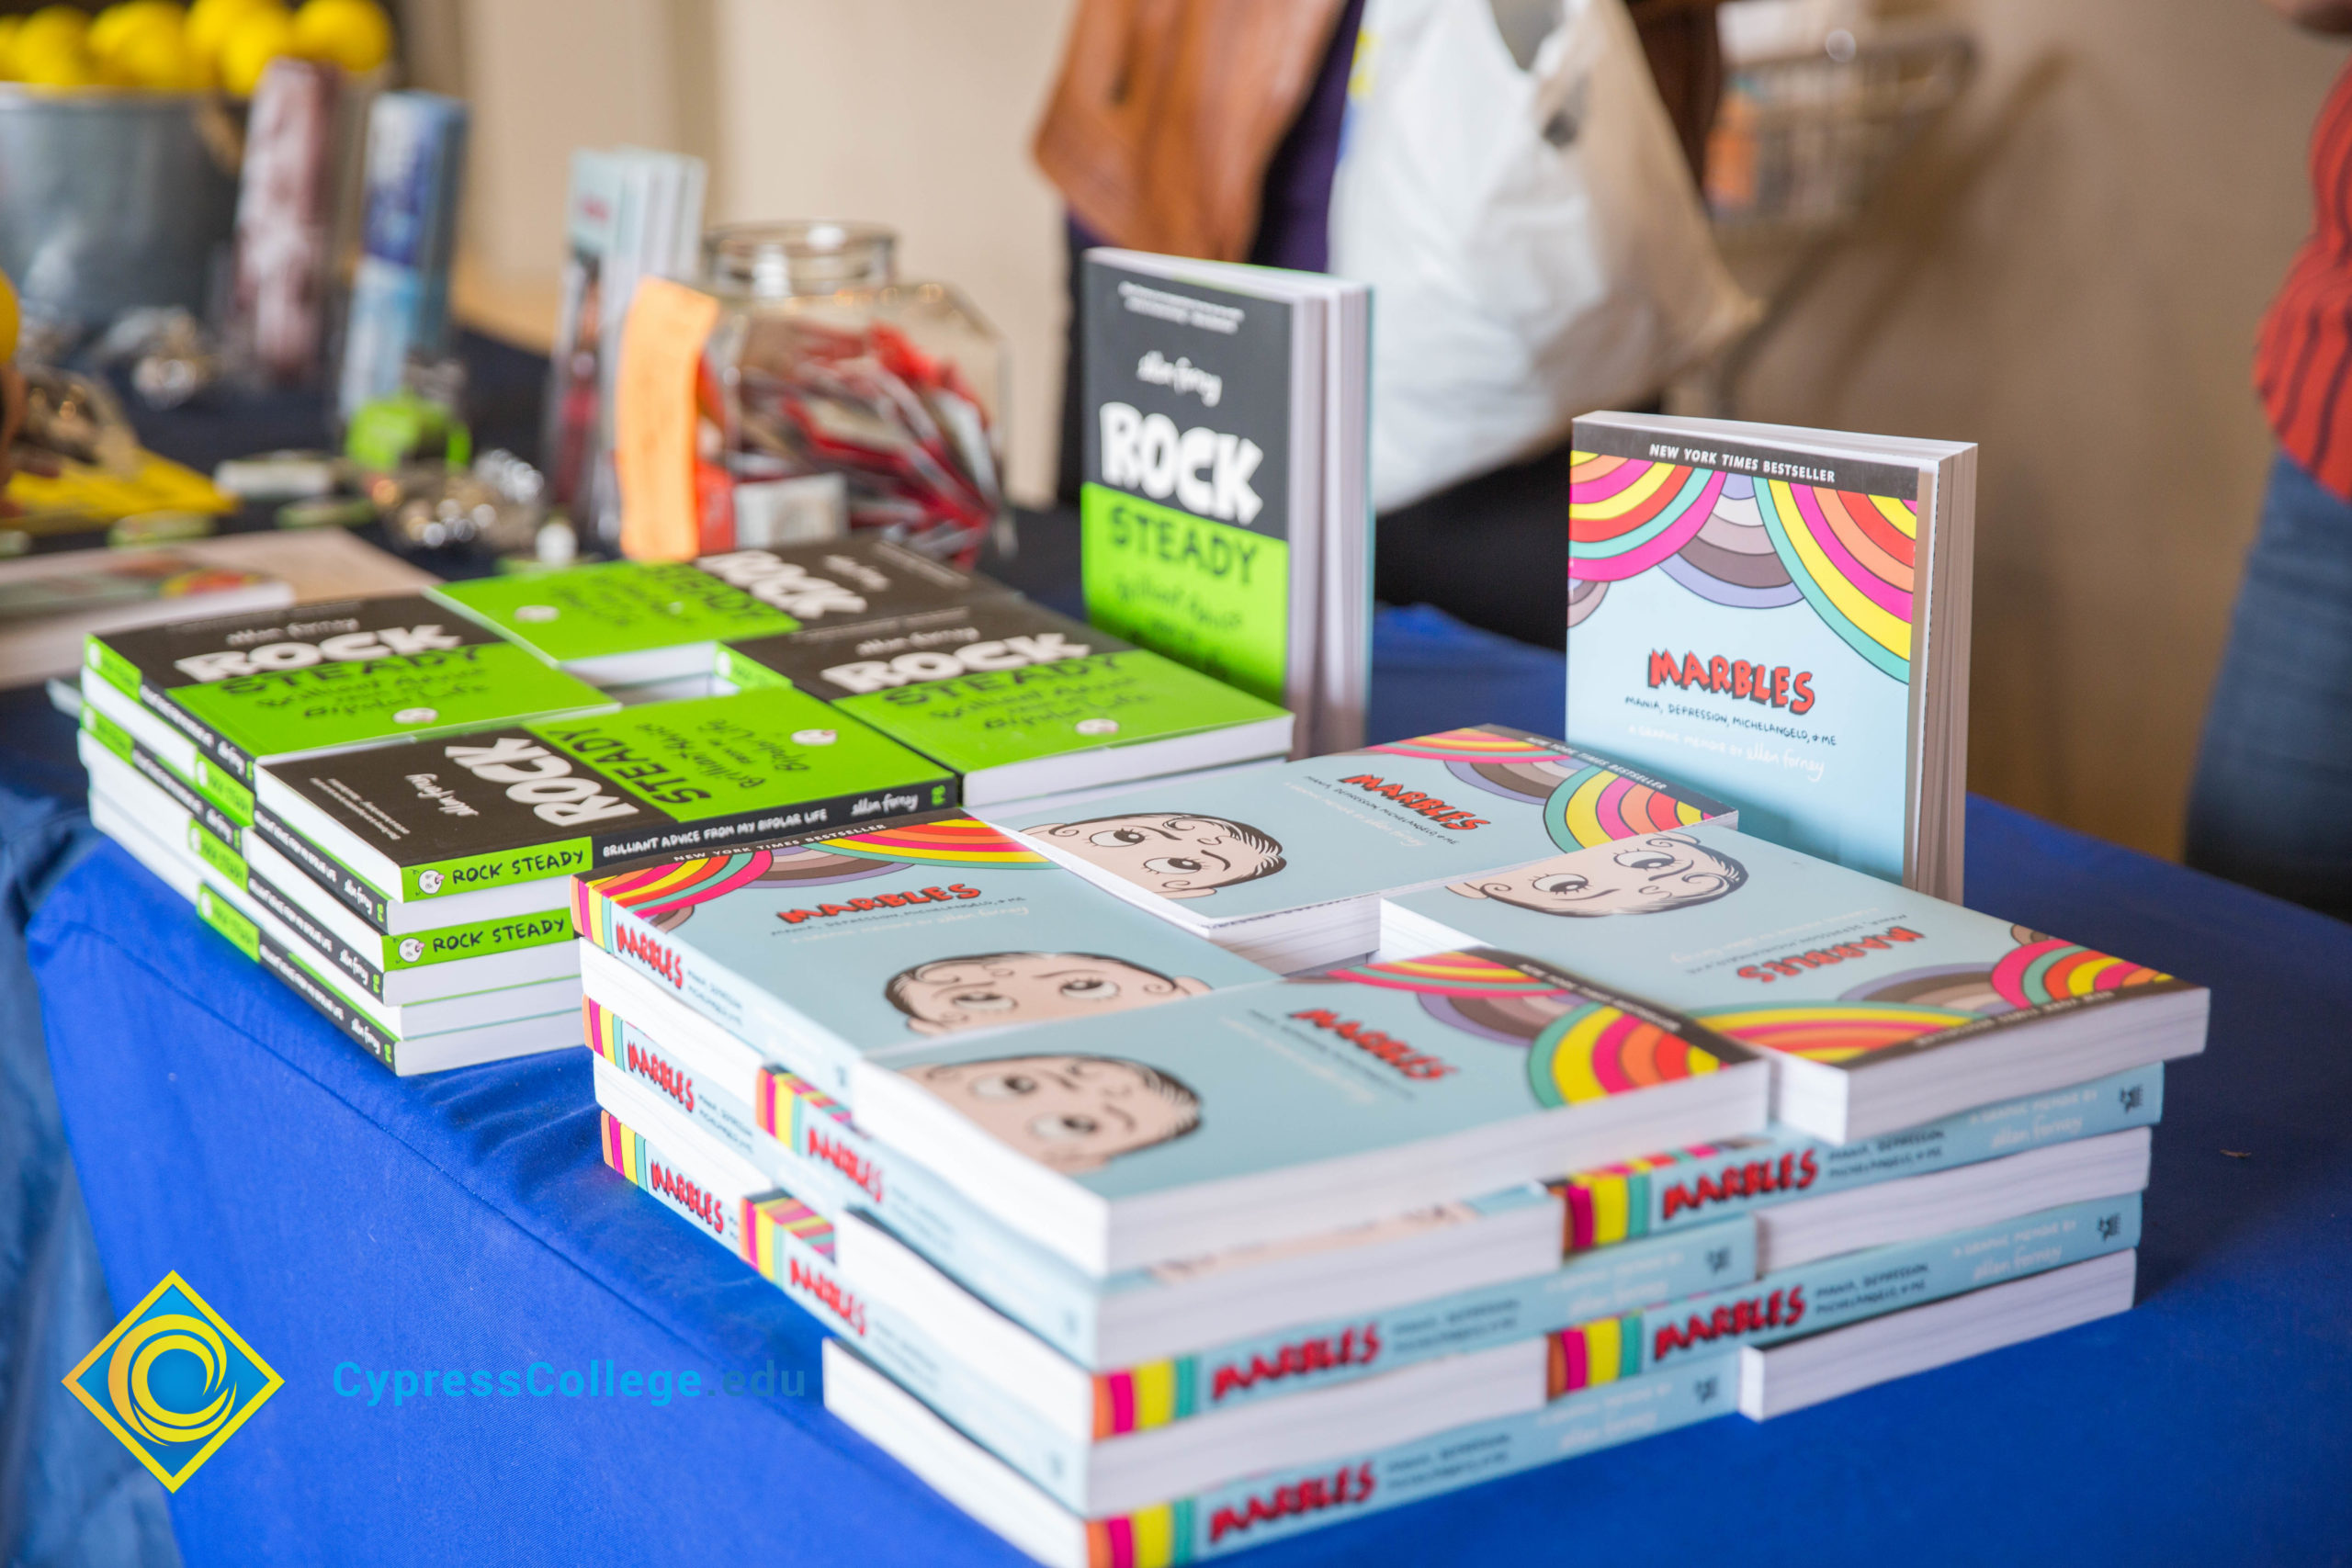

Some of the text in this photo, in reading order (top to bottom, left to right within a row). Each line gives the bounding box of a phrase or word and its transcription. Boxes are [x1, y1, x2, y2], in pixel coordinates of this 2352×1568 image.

[1100, 401, 1263, 525] ROCK
[1649, 444, 1836, 482] NEW YORK TIMES BESTSELLER
[1110, 506, 1256, 585] STEADY
[174, 625, 462, 682] ROCK
[220, 647, 481, 696] STEADY
[820, 632, 1091, 694] ROCK
[883, 654, 1121, 706] STEADY
[1648, 649, 1815, 716] MARBLES
[1625, 695, 1664, 714] MANIA,
[1668, 704, 1730, 727] DEPRESSION,
[1733, 716, 1811, 743] MICHELANGELO,
[1822, 736, 1837, 746] ME
[445, 738, 639, 826] ROCK
[548, 728, 712, 804] STEADY
[1609, 763, 1668, 790] BESTSELLER
[1746, 743, 1779, 764] ellen
[1782, 749, 1825, 783] forney
[1337, 774, 1491, 830] MARBLES
[452, 863, 503, 886] ROCK
[511, 849, 584, 874] STEADY
[603, 837, 659, 859] BRILLIANT
[661, 829, 700, 848] ADVICE
[703, 826, 735, 840] FROM
[737, 821, 756, 835] MY
[757, 813, 801, 832] BIPOLAR
[804, 808, 828, 824] LIFE
[673, 823, 887, 862] NEW YORK TIMES BESTSELLER
[433, 919, 566, 953] ROCK STEADY
[776, 883, 982, 924] MARBLES
[616, 922, 684, 989] MARBLES
[1736, 925, 1926, 983] MARBLES
[628, 1039, 695, 1113] MARBLES
[1287, 1009, 1460, 1081] MARBLES
[650, 1159, 724, 1234] MARBLES
[808, 1126, 885, 1203] MARBLES
[1661, 1147, 1819, 1221] MARBLES
[790, 1258, 866, 1337] MARBLES
[1653, 1283, 1807, 1361] MARBLES
[1212, 1324, 1382, 1403] MARBLES
[1209, 1461, 1377, 1545] MARBLES
